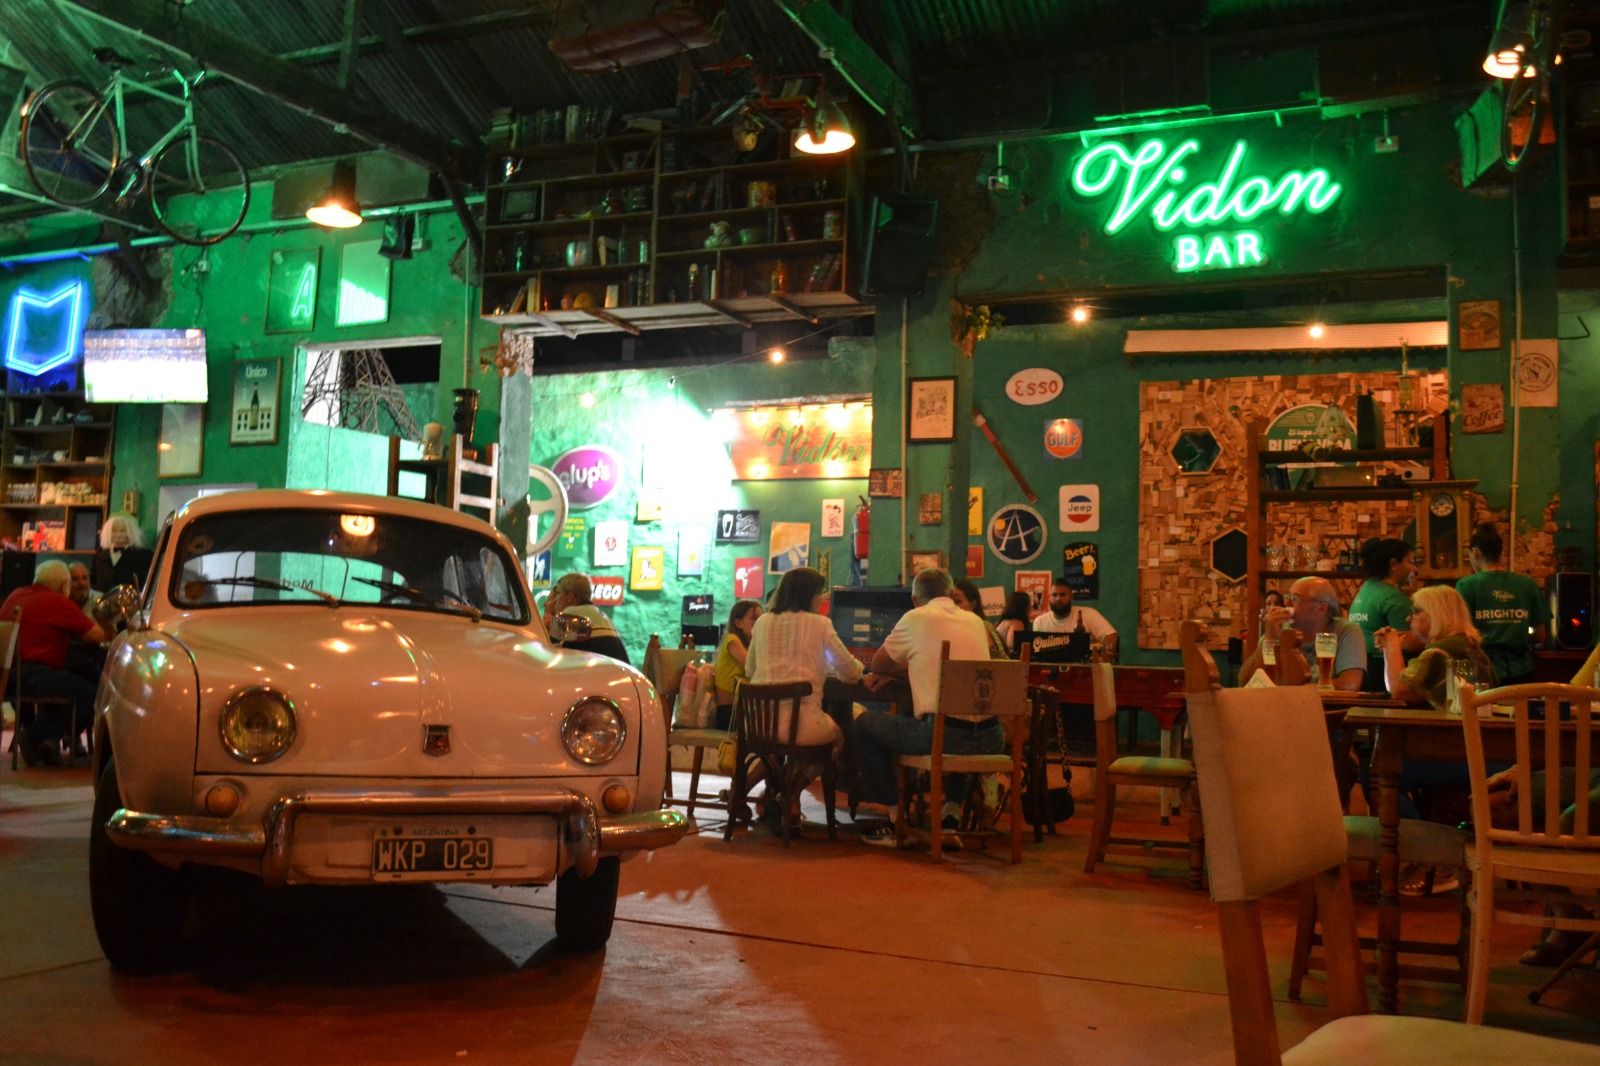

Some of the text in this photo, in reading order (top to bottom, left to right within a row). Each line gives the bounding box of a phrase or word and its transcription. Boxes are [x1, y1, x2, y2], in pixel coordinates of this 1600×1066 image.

[1072, 138, 1342, 234] Vidon
[1175, 232, 1263, 271] BAR
[245, 364, 268, 378] Único
[1463, 409, 1502, 427] Coffee
[1047, 432, 1078, 447] GULF
[1067, 503, 1092, 513] Jeep
[591, 583, 622, 600] EGO
[1475, 608, 1529, 620] BRIGHTON
[1033, 634, 1070, 653] Quilmes
[377, 839, 490, 871] WKP 029
